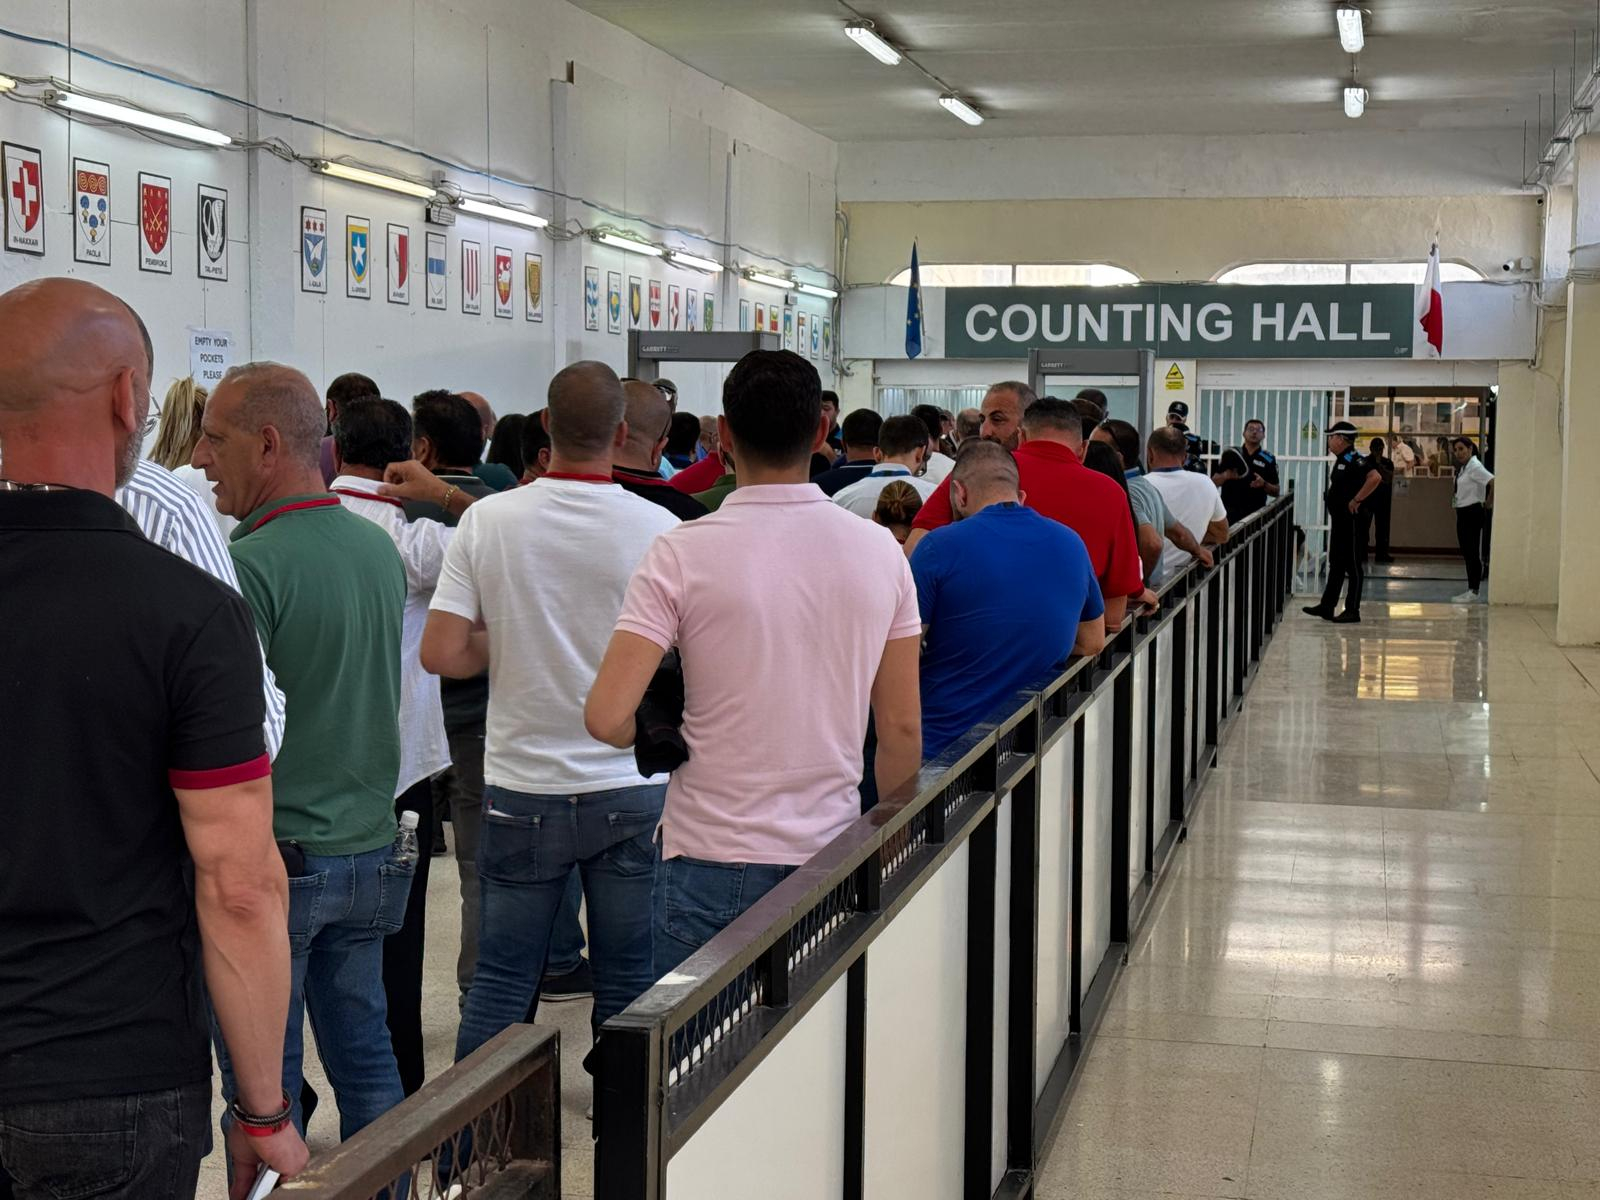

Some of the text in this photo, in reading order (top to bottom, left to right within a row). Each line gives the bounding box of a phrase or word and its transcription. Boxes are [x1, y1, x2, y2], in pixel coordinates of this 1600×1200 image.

[965, 302, 1391, 342] COUNTING HALL
[194, 336, 228, 348] EMPTY YOUR
[200, 353, 224, 363] POCKETS
[203, 370, 223, 379] PLEASE
